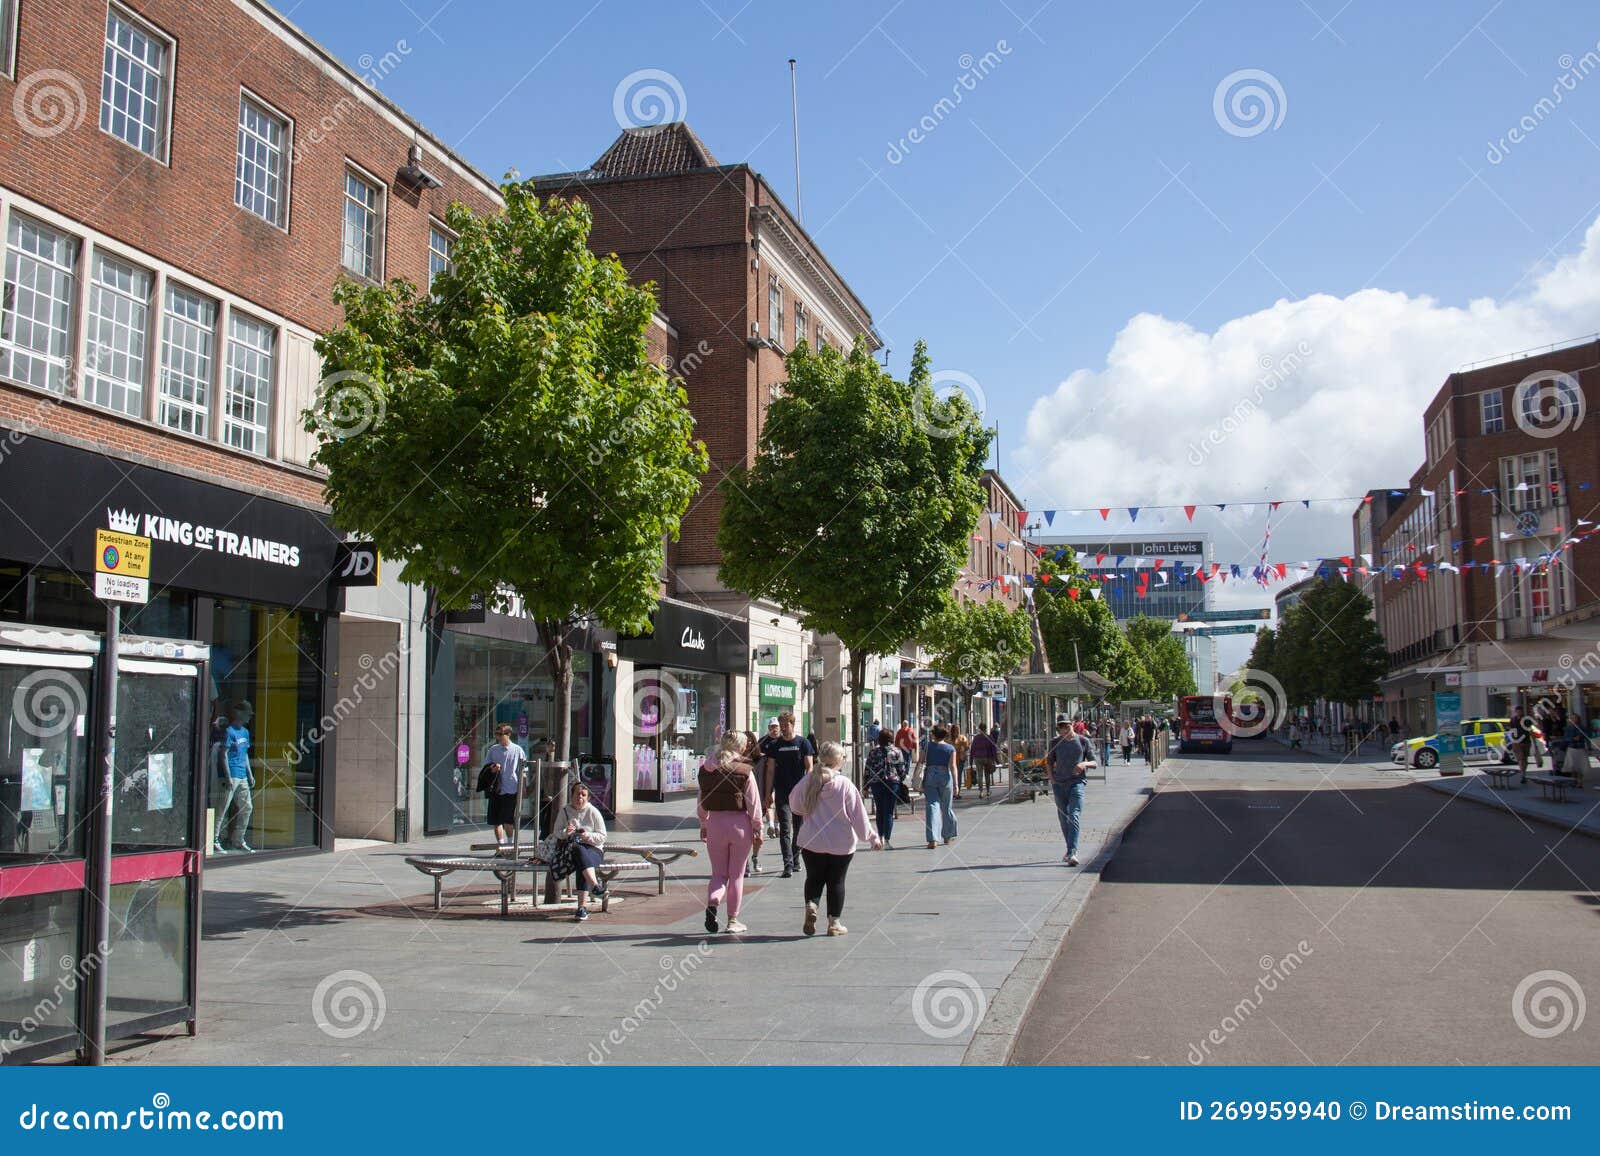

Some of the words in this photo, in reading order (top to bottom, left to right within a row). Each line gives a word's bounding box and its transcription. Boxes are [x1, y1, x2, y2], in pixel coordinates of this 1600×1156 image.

[99, 533, 133, 546] Pedestrian
[134, 539, 149, 548] Zone
[144, 513, 192, 546] KING
[195, 525, 213, 545] OF
[215, 530, 300, 567] TRAINERS
[1142, 543, 1166, 556] John
[1168, 542, 1197, 553] Lewis
[125, 551, 133, 559] At
[134, 553, 145, 562] any
[128, 561, 141, 570] time
[342, 551, 375, 577] JD
[106, 577, 115, 586] No
[117, 579, 139, 591] loading
[681, 626, 705, 650] Clarks
